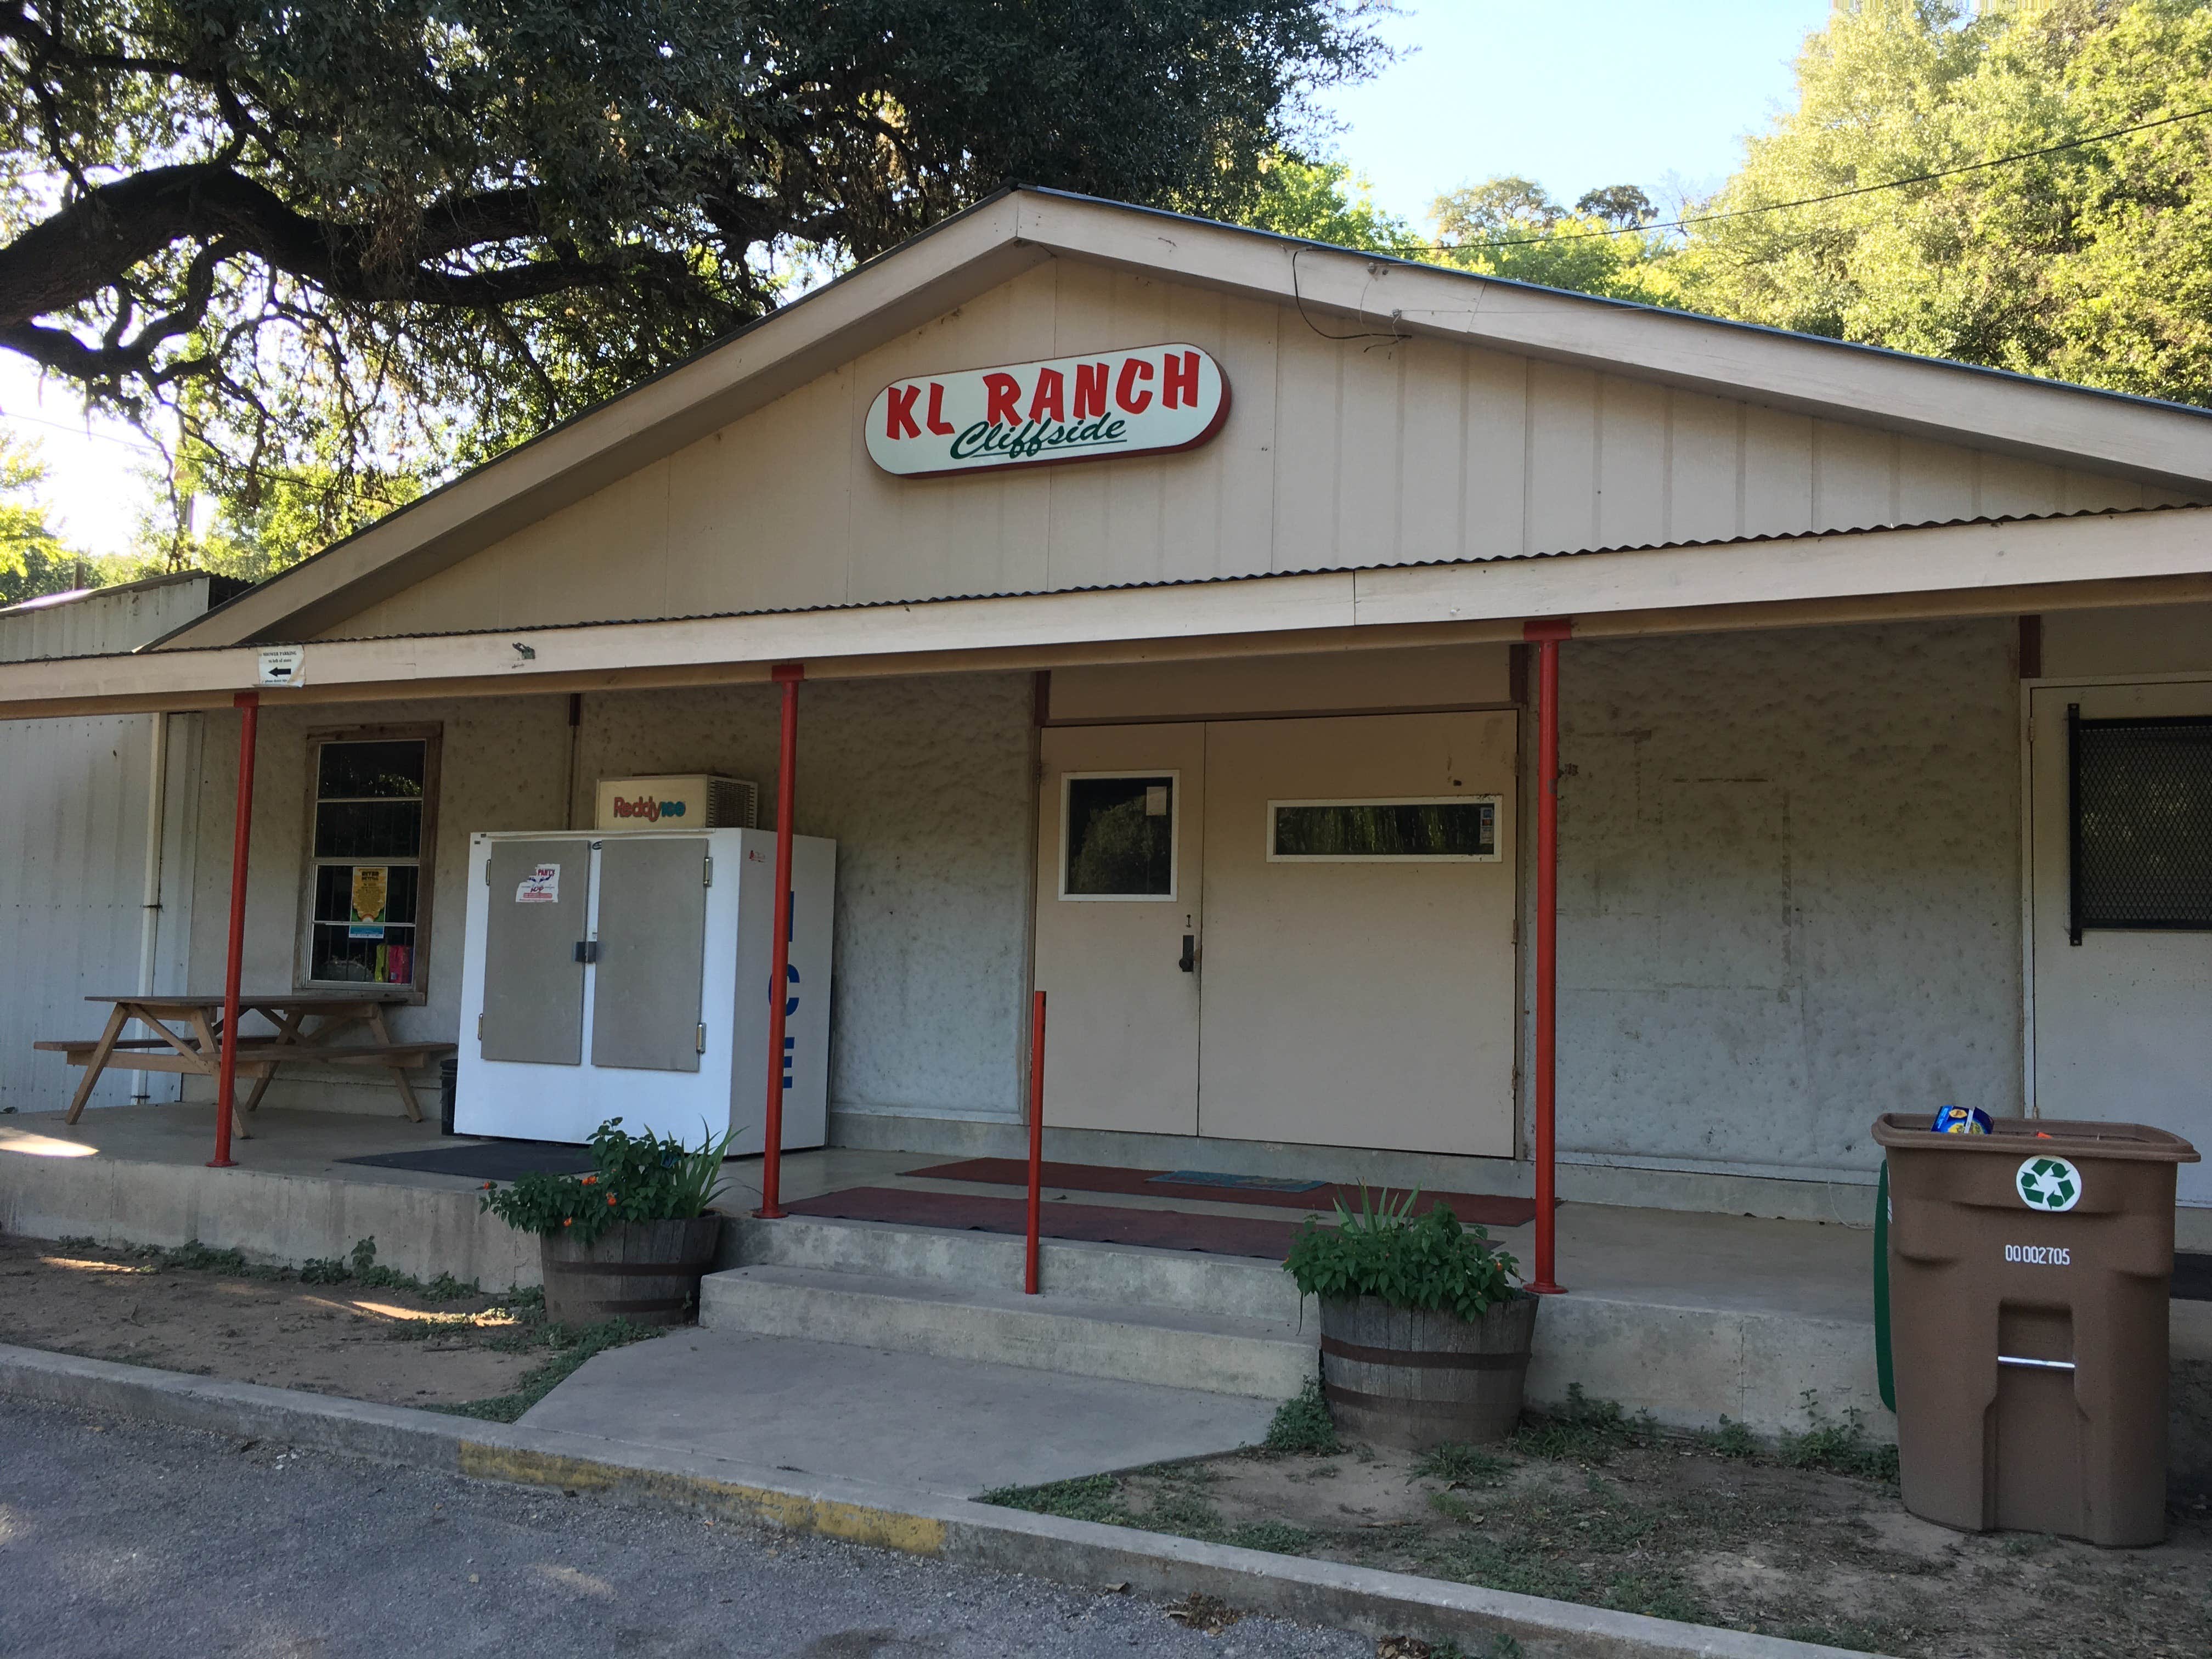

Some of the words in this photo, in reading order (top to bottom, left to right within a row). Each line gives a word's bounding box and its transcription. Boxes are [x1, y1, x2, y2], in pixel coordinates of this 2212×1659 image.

[886, 382, 956, 440] KL
[982, 350, 1201, 427] RANCH
[950, 411, 1126, 459] Cliffside
